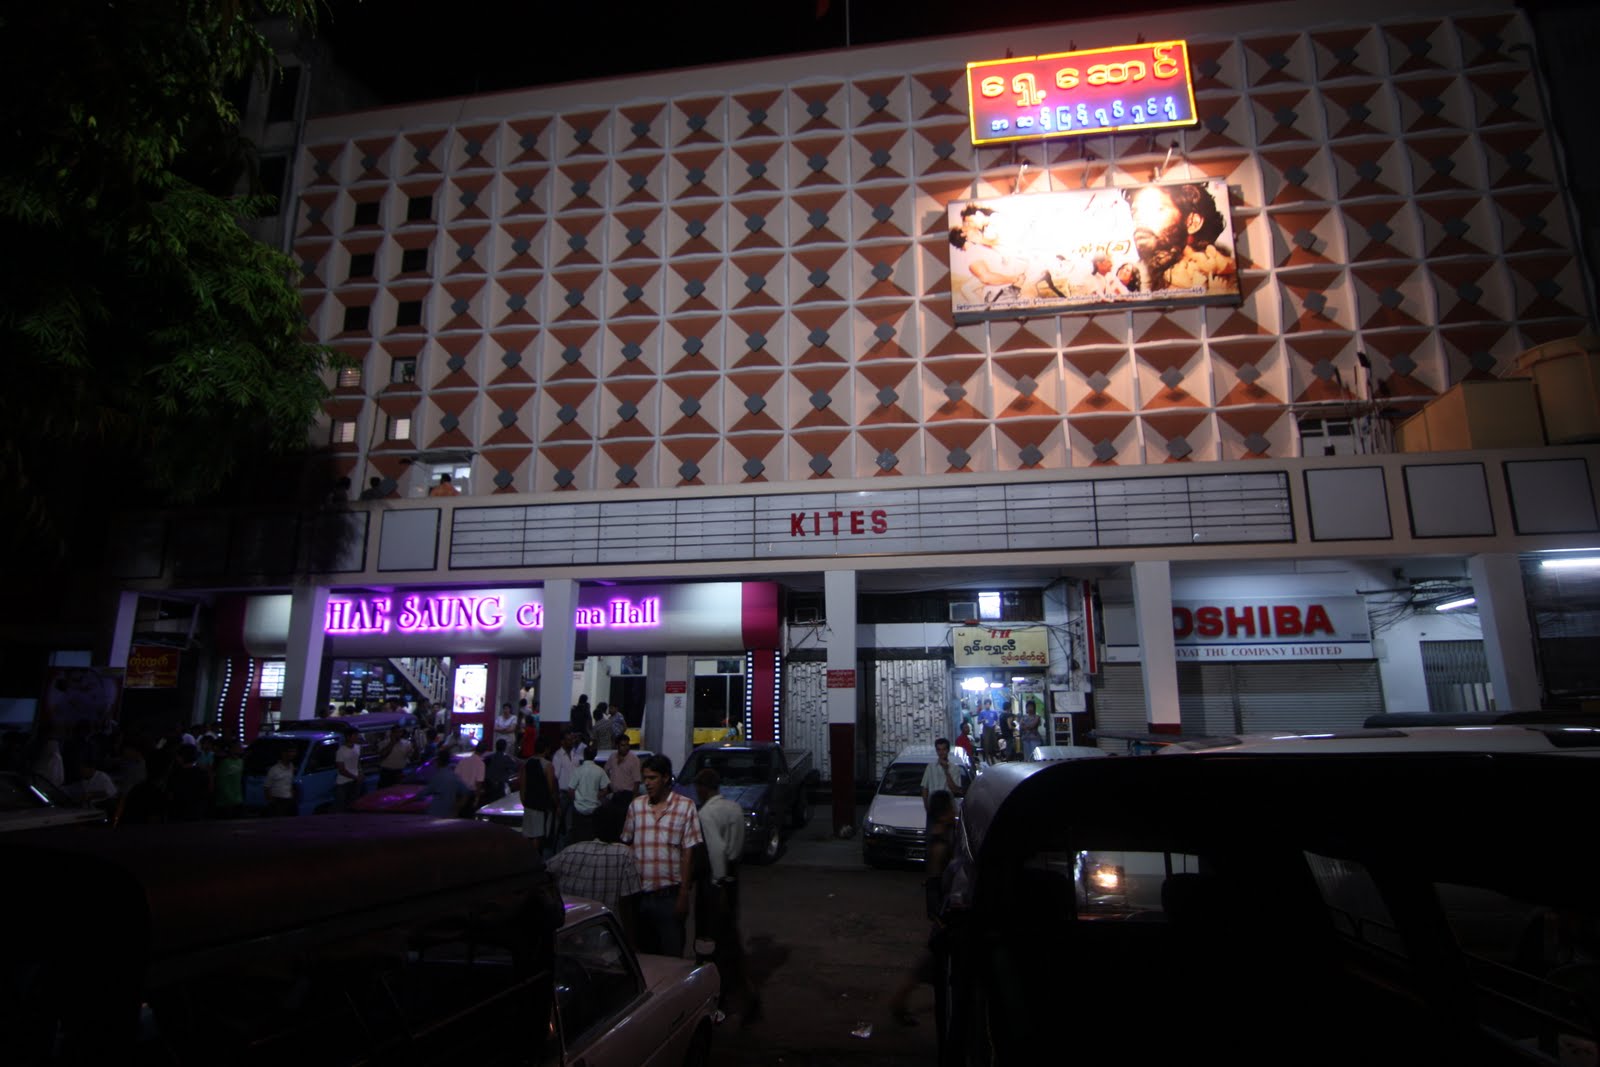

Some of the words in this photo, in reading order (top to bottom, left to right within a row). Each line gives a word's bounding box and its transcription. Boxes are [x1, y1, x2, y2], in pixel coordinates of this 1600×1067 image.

[791, 509, 887, 537] KITES
[326, 599, 390, 631] HAE
[397, 596, 503, 630] SAUNG
[516, 603, 603, 626] Cima
[610, 599, 660, 625] Hall
[1172, 604, 1336, 638] OSHIBA
[1205, 647, 1228, 658] THU
[1231, 647, 1287, 658] COMPANY
[1292, 646, 1343, 656] LIMITED
